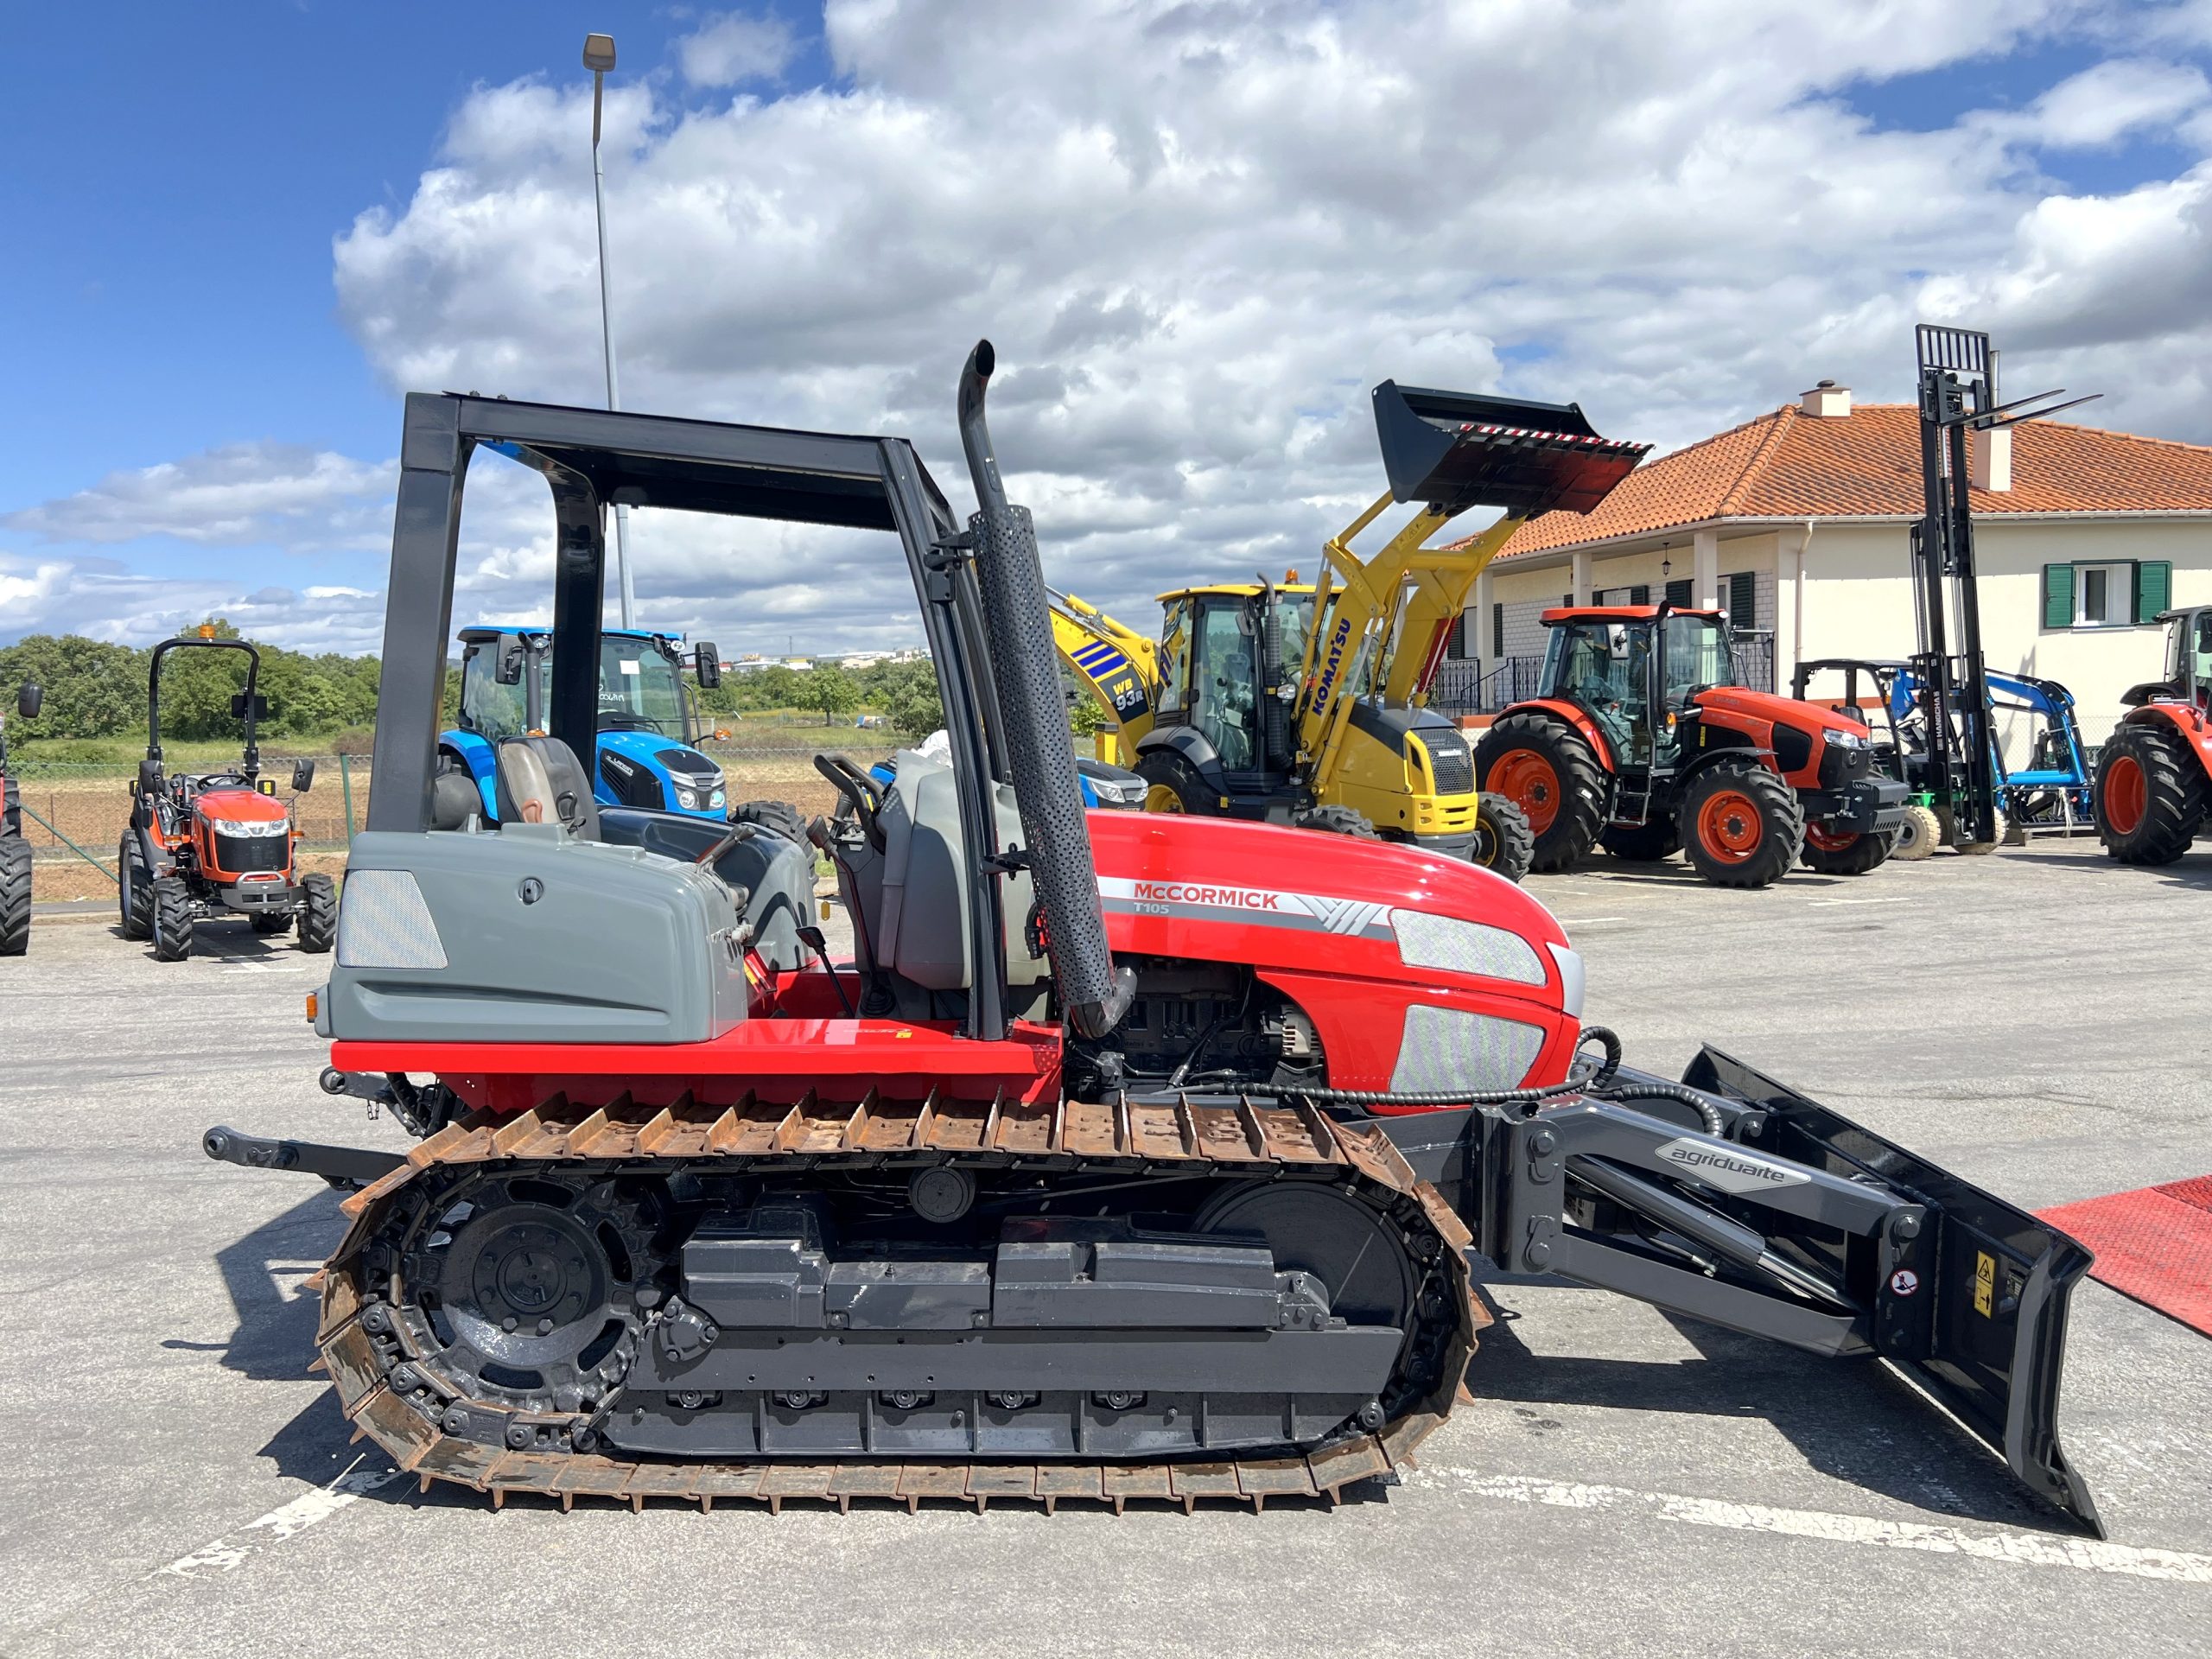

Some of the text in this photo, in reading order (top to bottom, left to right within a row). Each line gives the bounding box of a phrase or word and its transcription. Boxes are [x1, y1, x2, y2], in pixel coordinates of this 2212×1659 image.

[1312, 618, 1351, 716] KOMATSU
[1113, 678, 1134, 696] WB
[1116, 690, 1144, 711] 93R
[1134, 902, 1170, 914] T105
[1670, 1148, 1785, 1182] agriduarte
